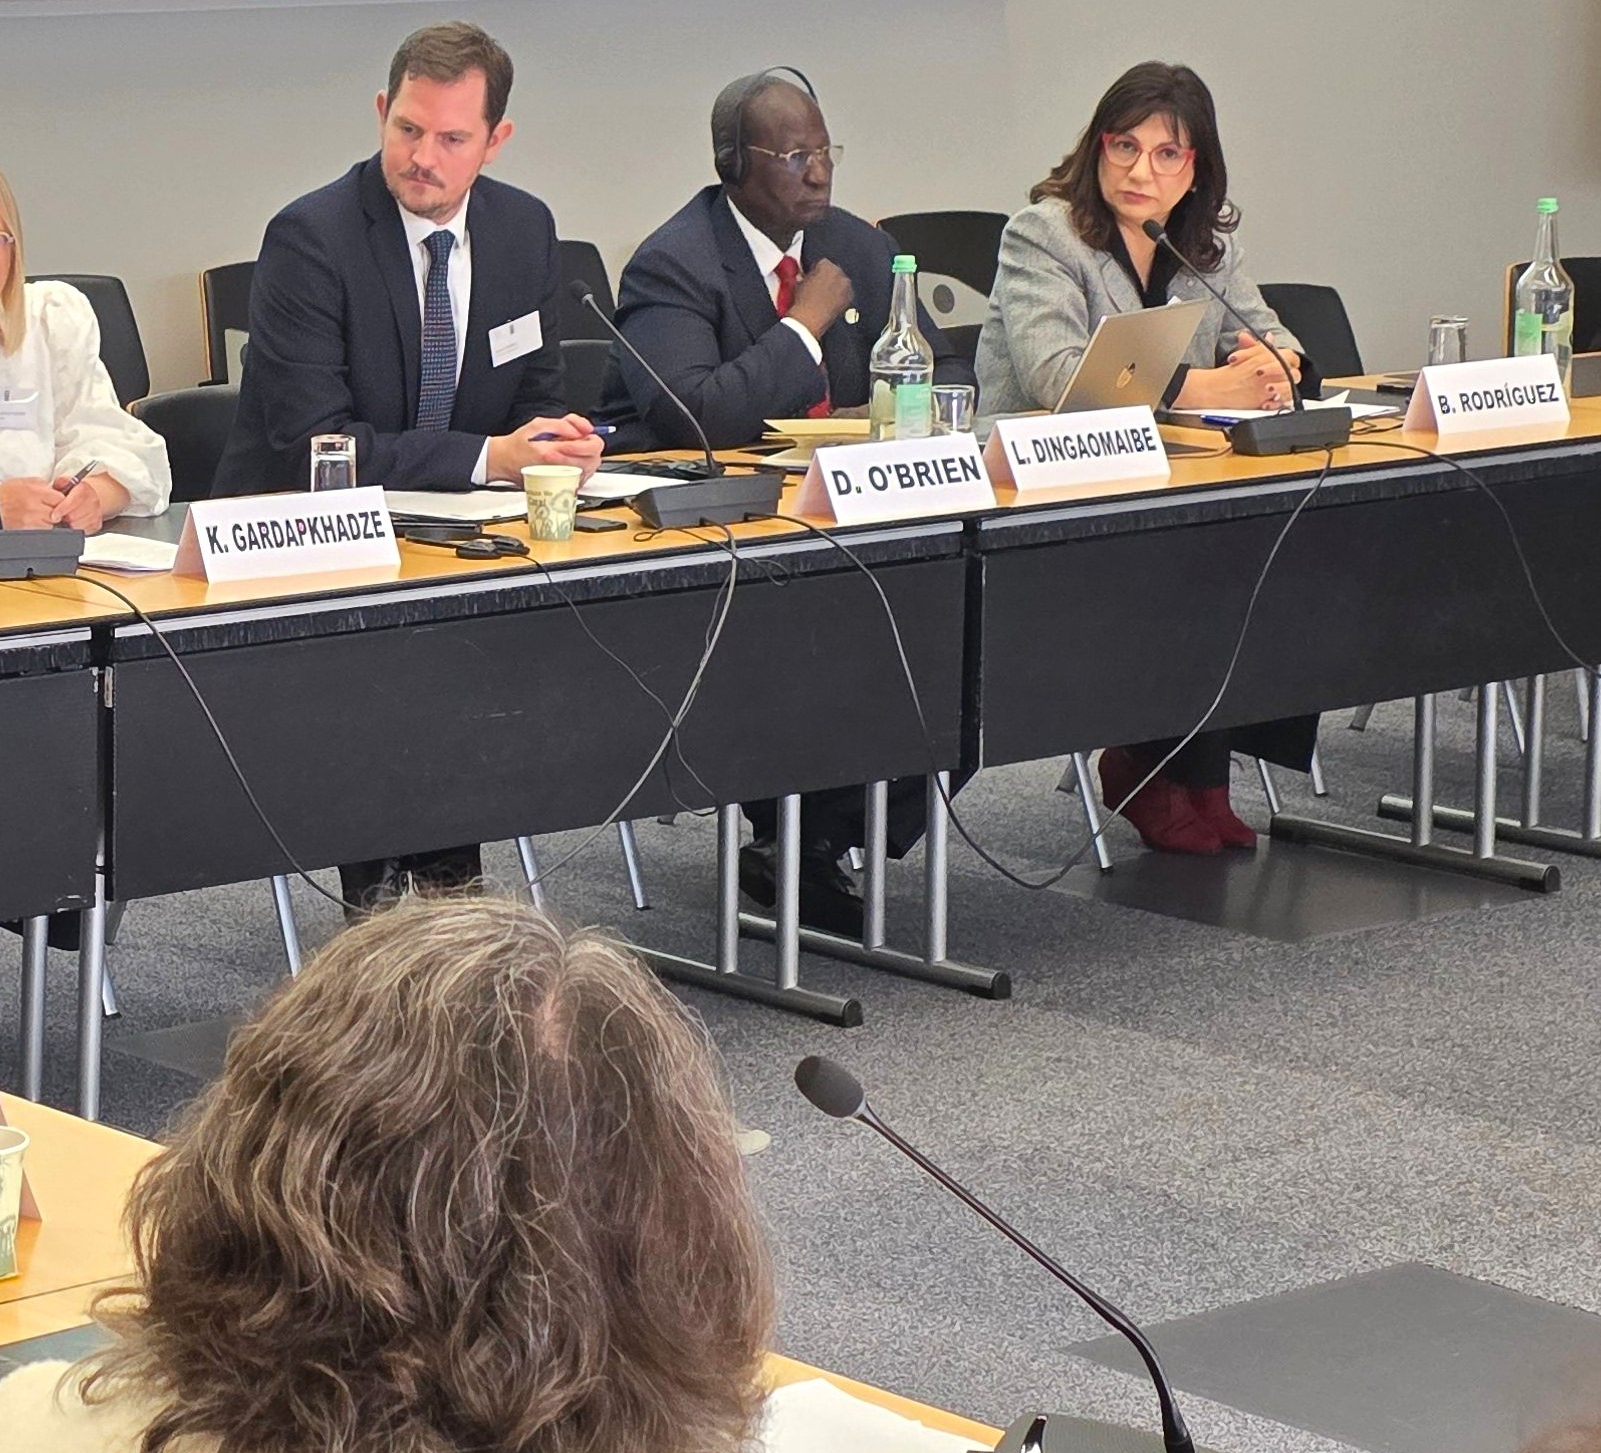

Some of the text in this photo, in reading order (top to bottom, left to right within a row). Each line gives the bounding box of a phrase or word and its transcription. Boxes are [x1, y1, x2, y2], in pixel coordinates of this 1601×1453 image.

[1437, 382, 1560, 415] B. RODRÍGUEZ
[1011, 427, 1157, 465] L. DINGAOMAIBE
[831, 455, 981, 496] D. O'BRIEN
[205, 510, 386, 554] K. GARDAPKHADZE
